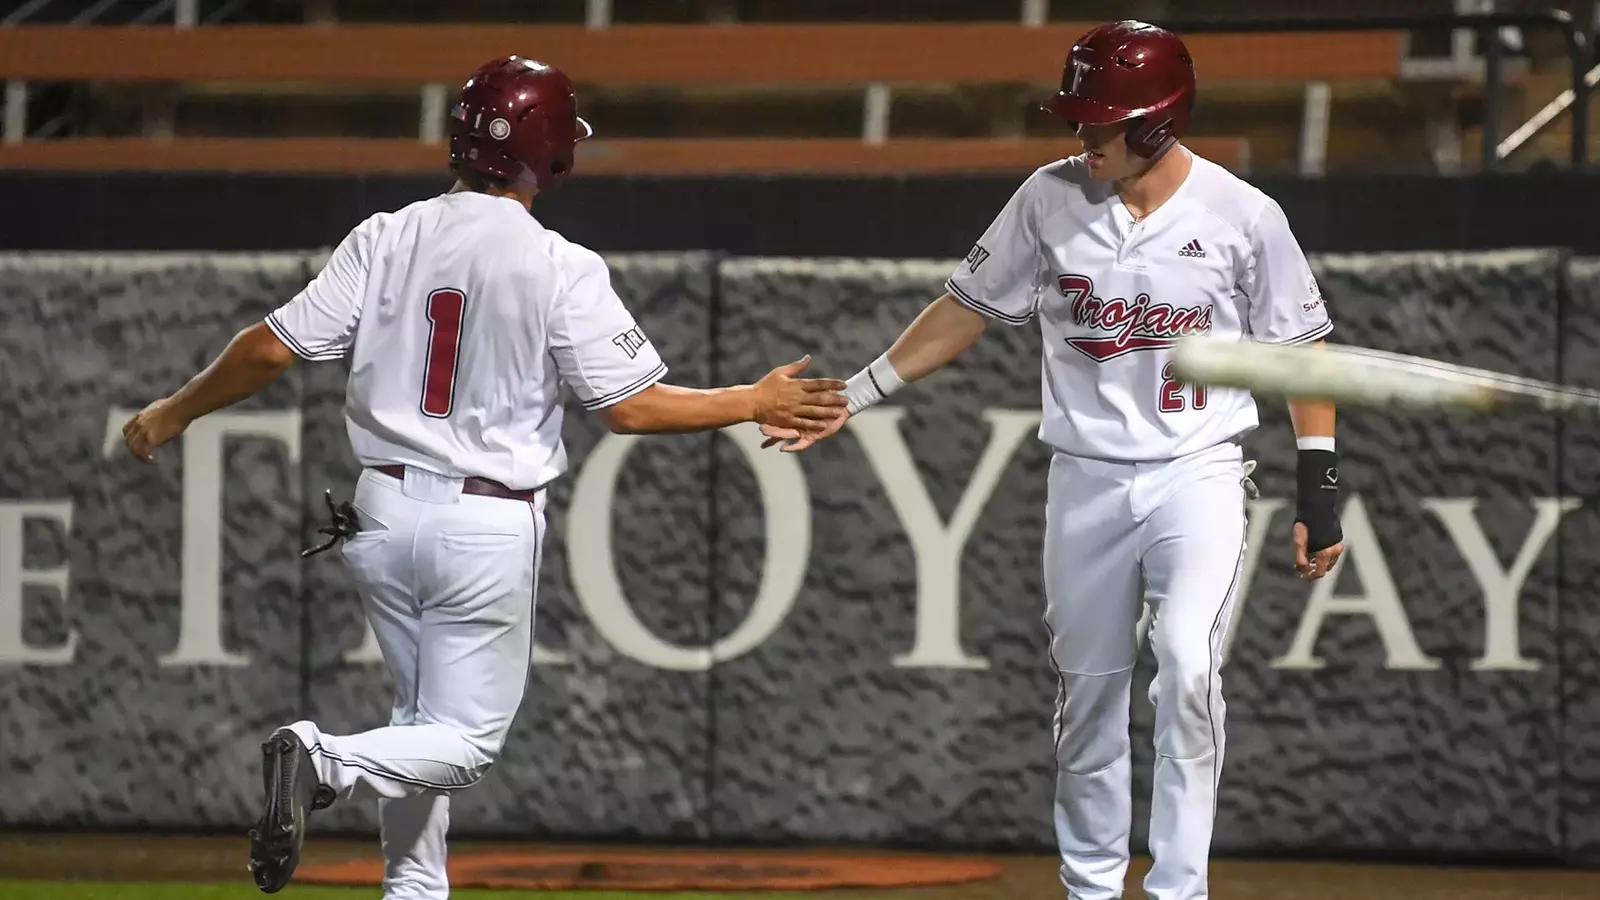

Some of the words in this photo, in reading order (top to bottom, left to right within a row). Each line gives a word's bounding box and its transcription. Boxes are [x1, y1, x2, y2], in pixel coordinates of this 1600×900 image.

[1177, 250, 1206, 258] adidas
[1058, 274, 1213, 347] Trojans
[420, 287, 467, 419] 1
[1159, 361, 1208, 412] 21
[103, 406, 1042, 671] TOY
